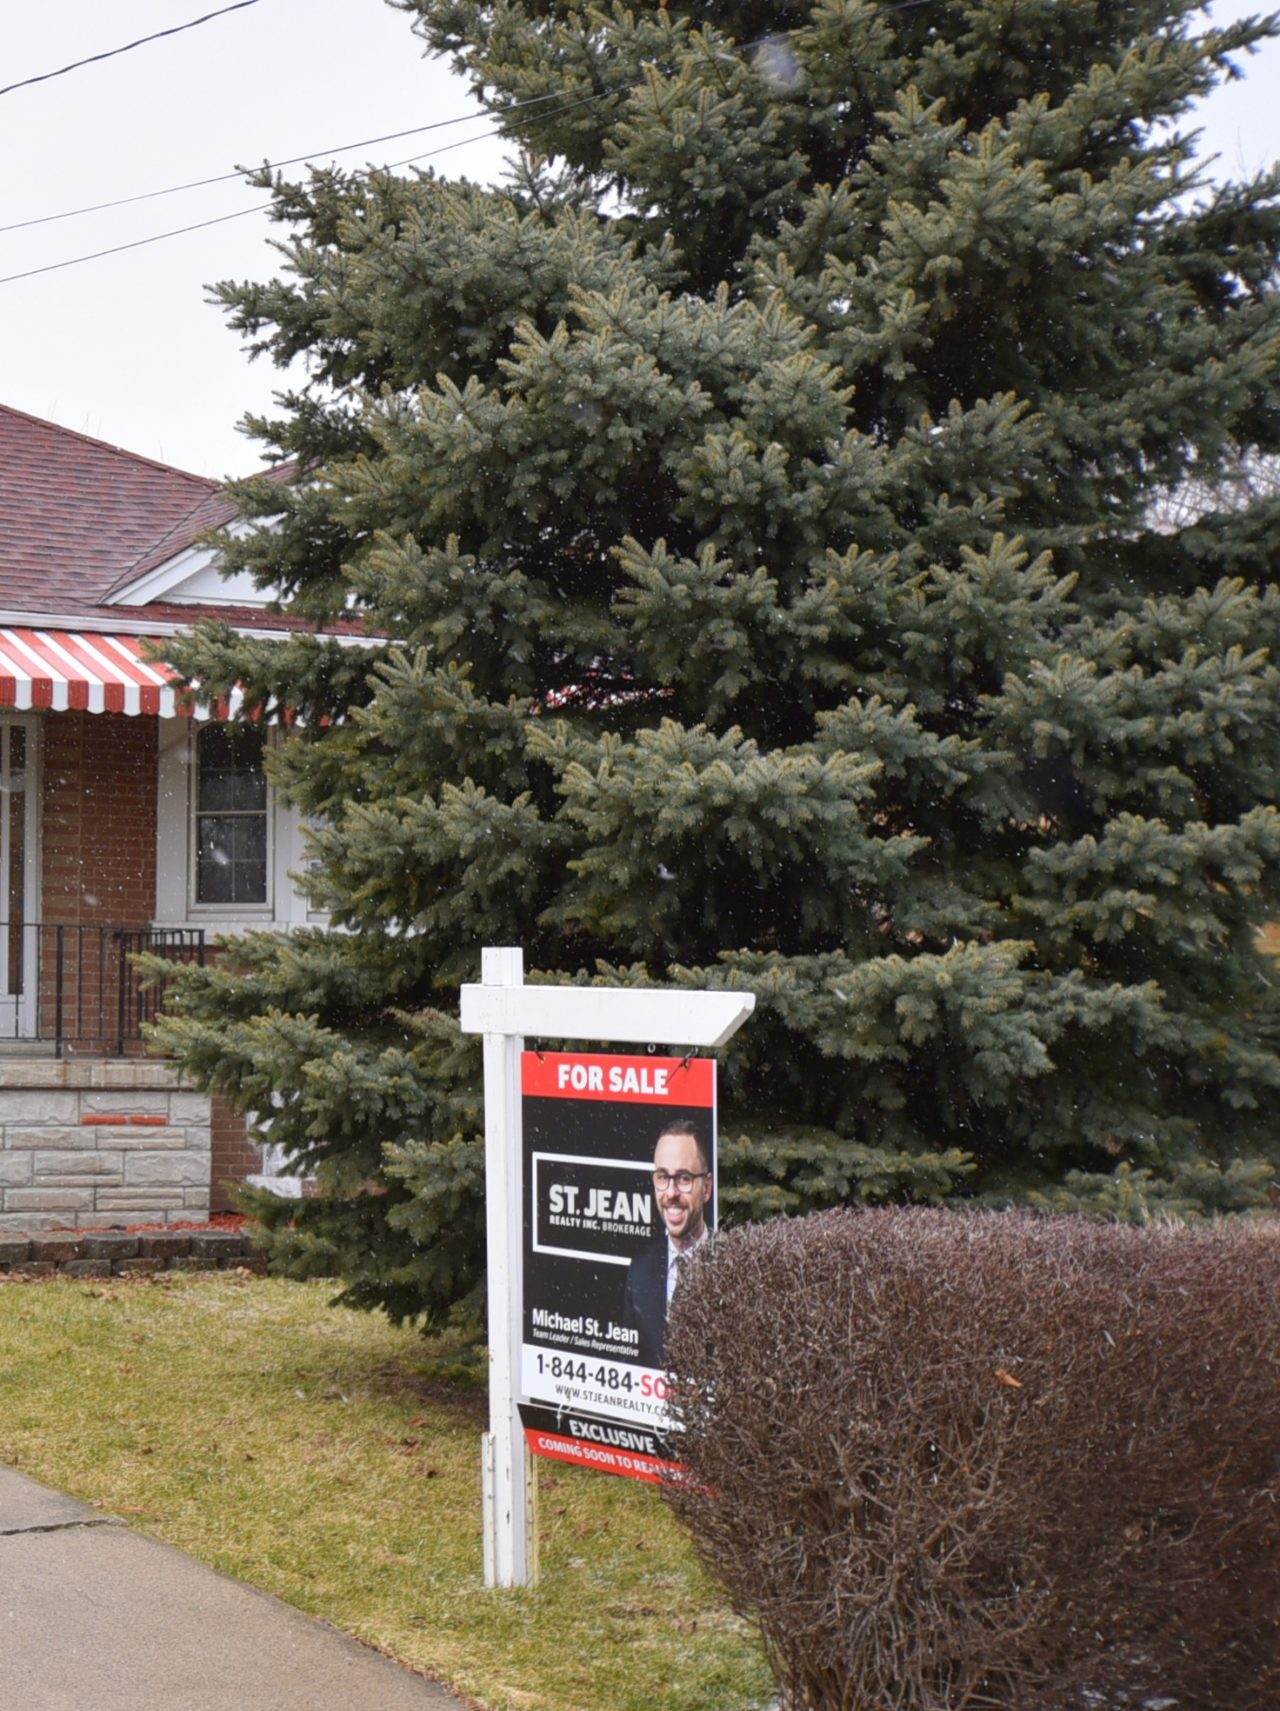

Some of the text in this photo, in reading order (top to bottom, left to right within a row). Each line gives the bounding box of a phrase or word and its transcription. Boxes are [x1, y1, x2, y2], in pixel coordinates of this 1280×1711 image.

[558, 1064, 669, 1095] FOR SALE
[549, 1184, 651, 1224] ST. JEAN
[549, 1215, 651, 1237] REALTY INC. BROKERAGE
[532, 1308, 639, 1344] Michael St. Jean
[532, 1328, 548, 1339] Team
[549, 1332, 570, 1344] Leader
[574, 1336, 590, 1348] Sales
[591, 1340, 639, 1357] Representative
[537, 1353, 678, 1401] 1-844-484-SO
[555, 1384, 675, 1419] WWW.STJEANREALTY.CO
[538, 1437, 582, 1457] COMING
[583, 1447, 614, 1465] SOON
[615, 1454, 632, 1469] TO
[569, 1420, 656, 1453] EXCLUSIVE
